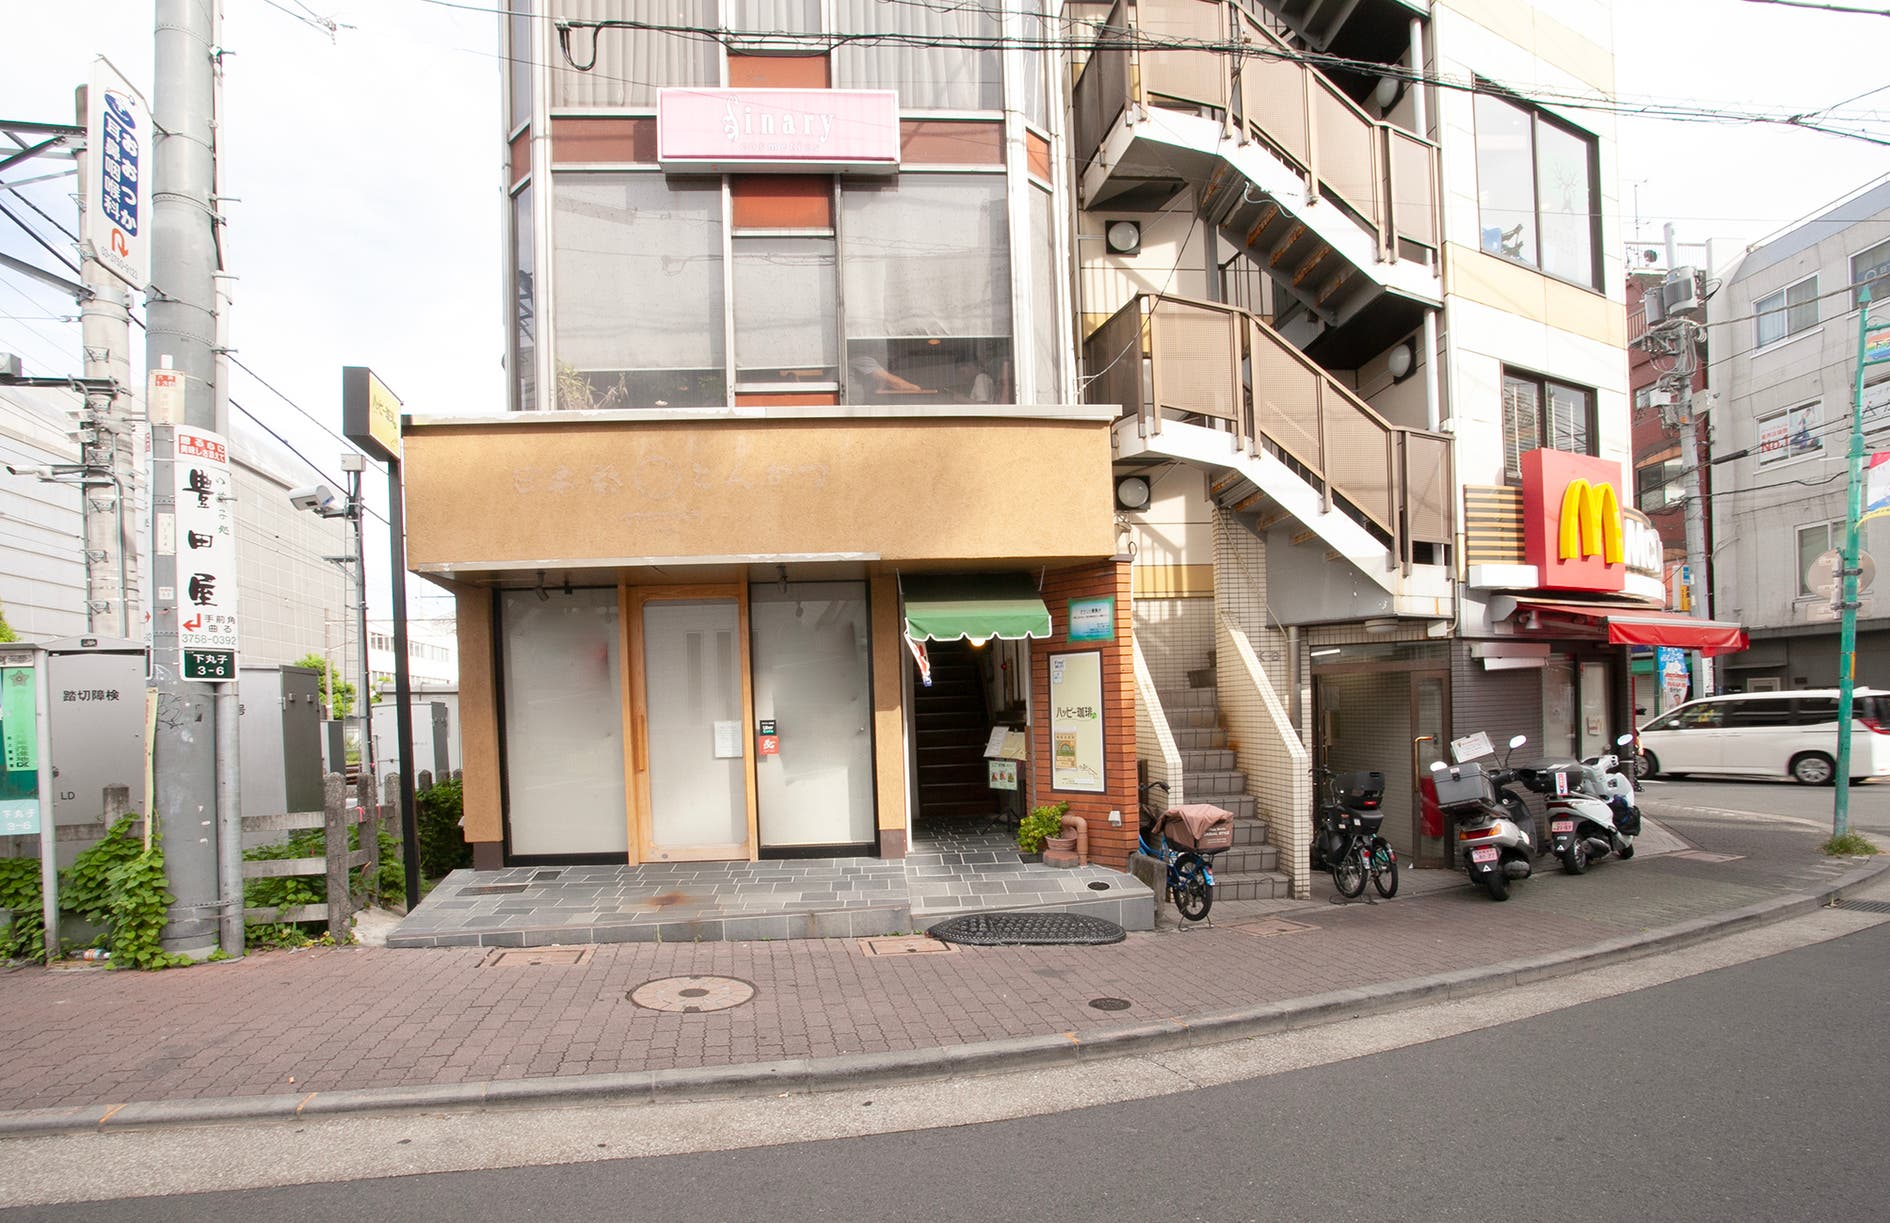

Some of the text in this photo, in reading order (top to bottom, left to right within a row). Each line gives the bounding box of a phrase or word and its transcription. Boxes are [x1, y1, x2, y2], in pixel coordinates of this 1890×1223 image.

[104, 115, 122, 221] 耳鼻咽喉科
[121, 132, 138, 231] おおつか
[204, 614, 236, 625] 手前角
[208, 624, 233, 634] 曲る
[181, 633, 237, 645] 3758-0392
[193, 653, 228, 664] 下丸子
[197, 665, 225, 676] 3-6
[63, 690, 120, 702] 踏切障検
[1056, 705, 1092, 719] ハッピー珈琲
[60, 791, 76, 801] LD
[7, 820, 32, 831] 3-6
